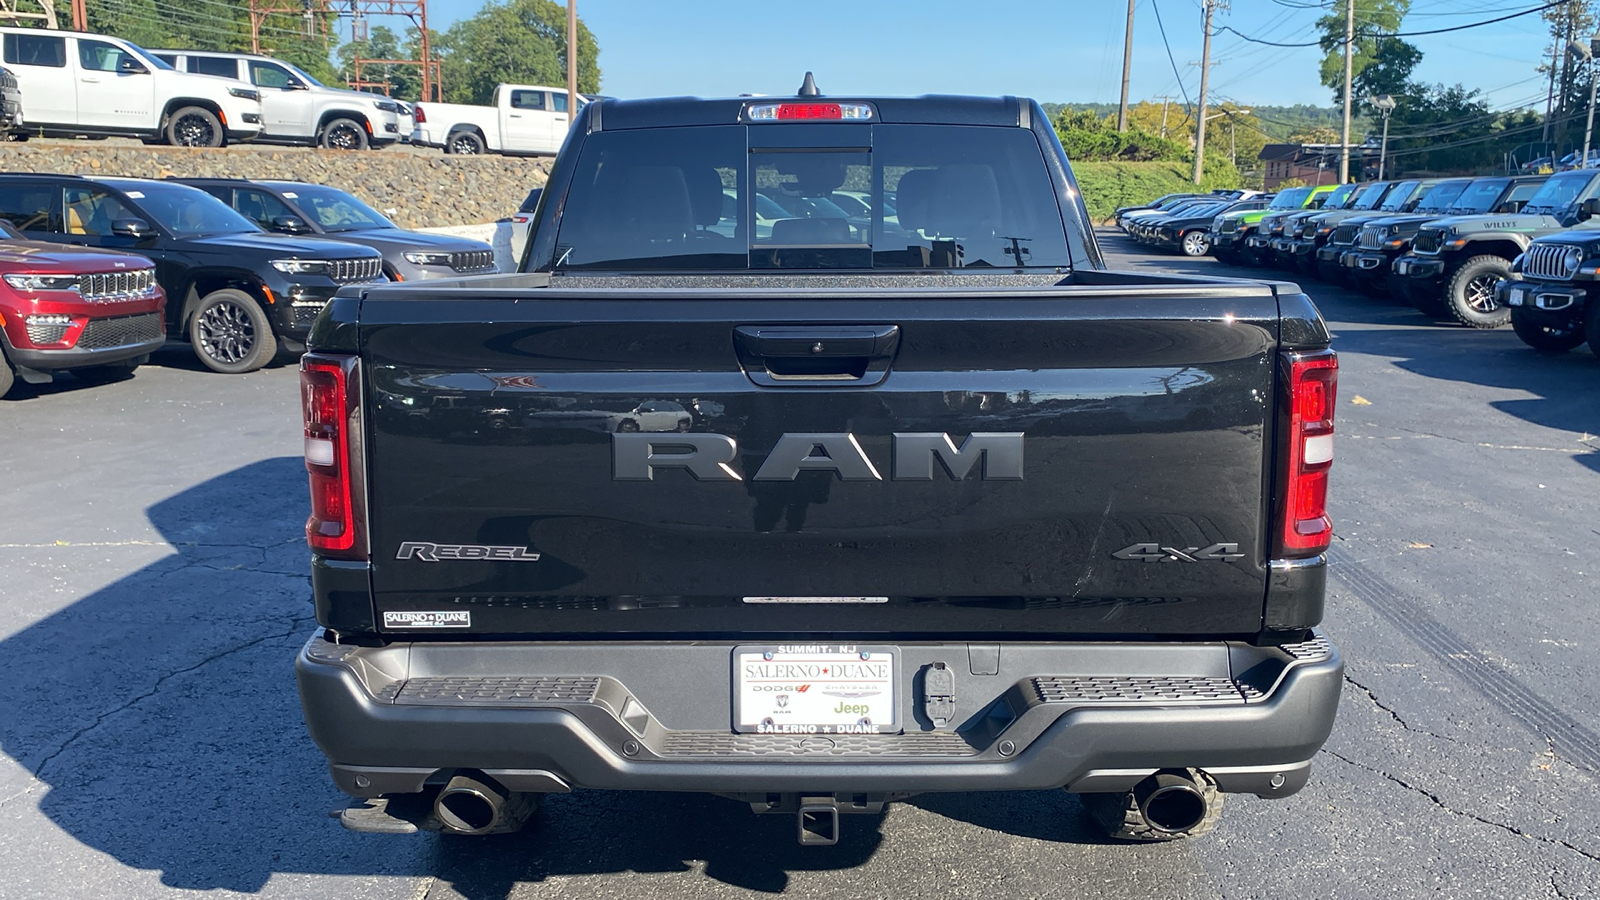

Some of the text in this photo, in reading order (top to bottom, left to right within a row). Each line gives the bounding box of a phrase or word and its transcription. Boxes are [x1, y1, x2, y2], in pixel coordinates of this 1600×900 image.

[1483, 221, 1517, 229] WILLYS
[612, 432, 1024, 481] RAM
[396, 541, 540, 562] REBEL
[386, 613, 467, 622] SALERNO DUANE
[839, 645, 857, 654] NJ
[745, 664, 888, 678] SALERNO DUANE
[834, 701, 870, 716] Jeep
[757, 724, 880, 734] SALERNO DUANE
